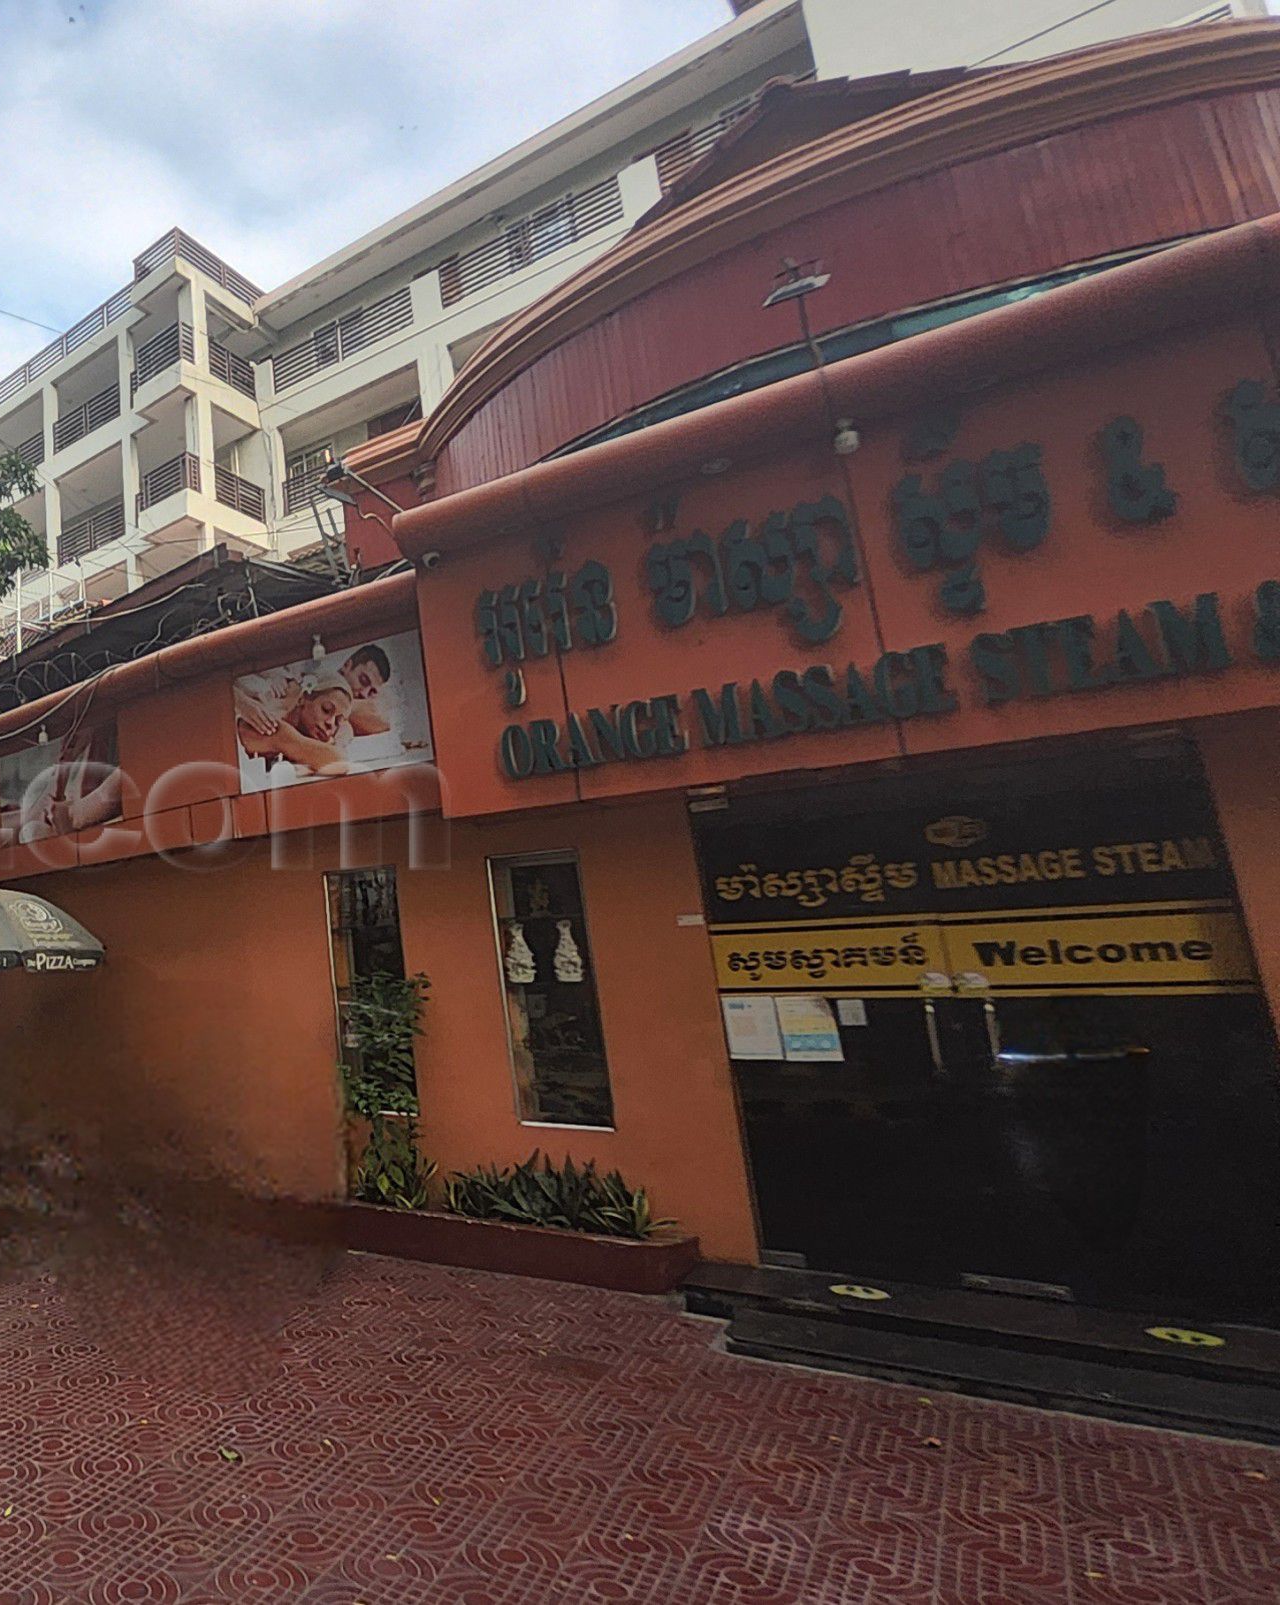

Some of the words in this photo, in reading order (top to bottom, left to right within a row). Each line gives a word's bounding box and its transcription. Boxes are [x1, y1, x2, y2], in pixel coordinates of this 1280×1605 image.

[500, 693, 689, 779] ORANGE
[691, 642, 960, 747] MASSAGE
[970, 592, 1233, 704] STEAM
[931, 848, 1086, 889] MASSAGE
[1092, 836, 1216, 876] STEAM
[36, 953, 75, 970] PIZZA
[972, 938, 1213, 967] Welcome
